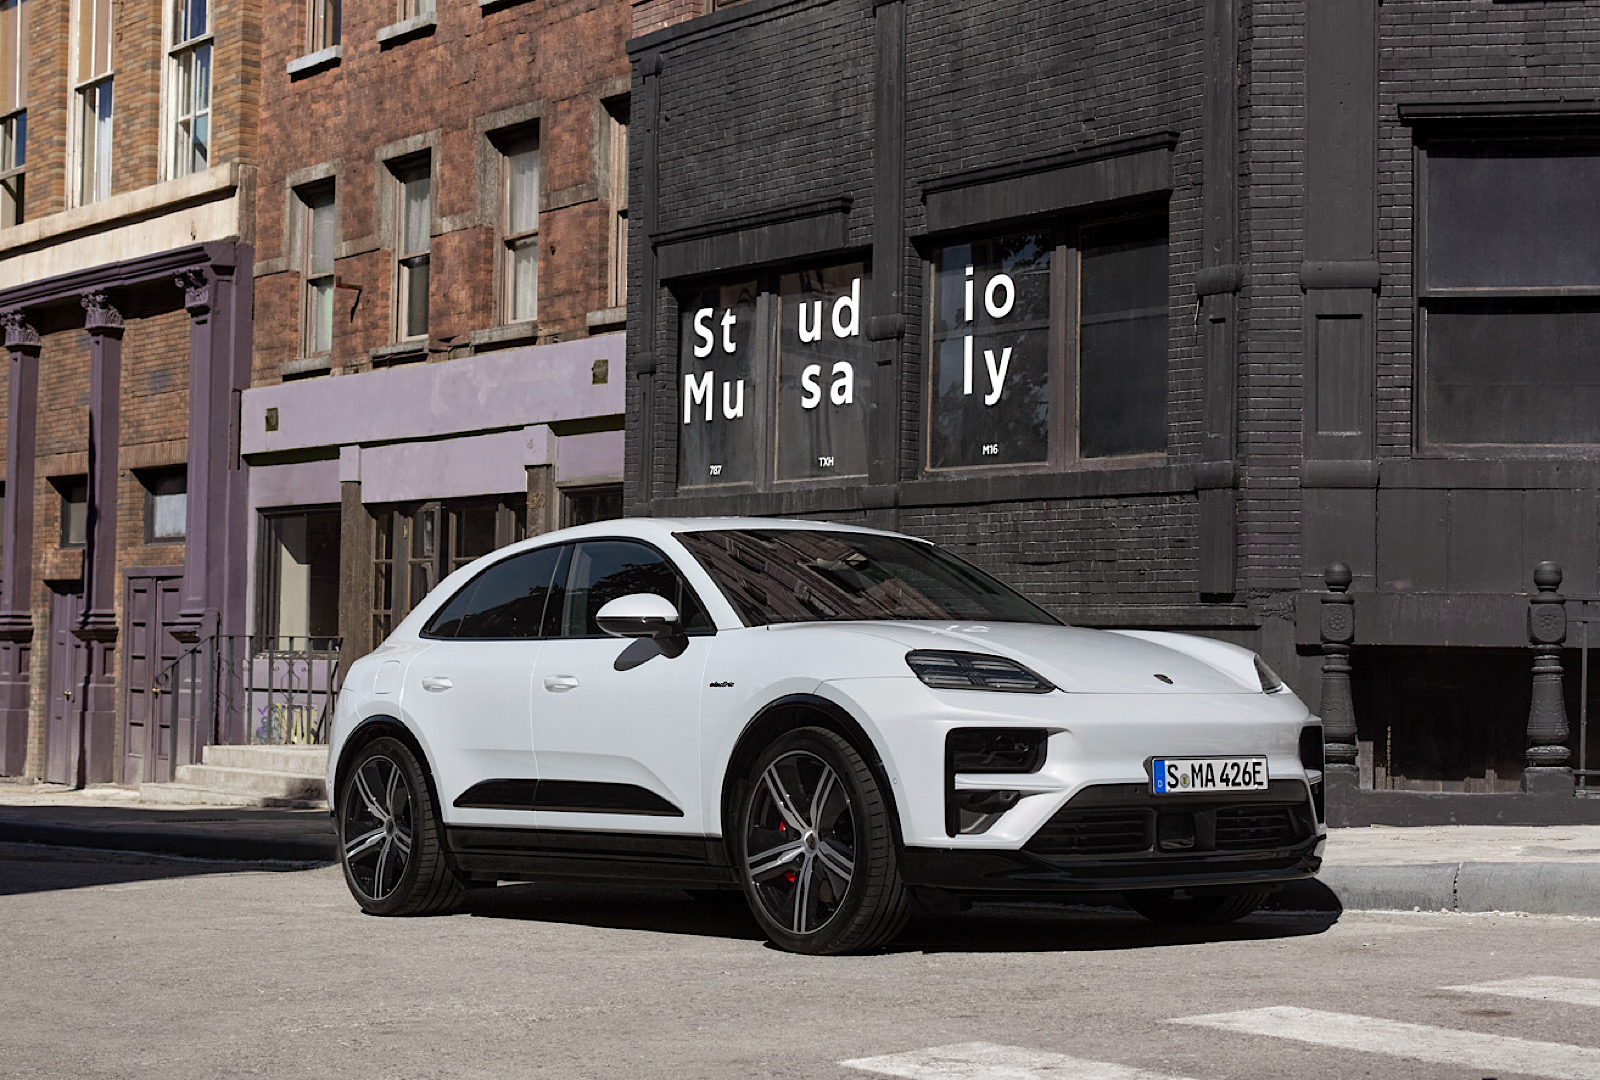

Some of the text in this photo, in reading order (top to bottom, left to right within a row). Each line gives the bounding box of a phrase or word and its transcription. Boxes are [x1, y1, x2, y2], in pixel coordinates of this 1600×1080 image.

[693, 264, 1015, 358] St ud io
[683, 335, 1013, 424] Mu sa ly
[982, 443, 999, 455] M16
[817, 456, 835, 468] TXH
[709, 464, 722, 476] 787
[1167, 761, 1264, 788] S MA 426E
[1157, 780, 1163, 788] D
